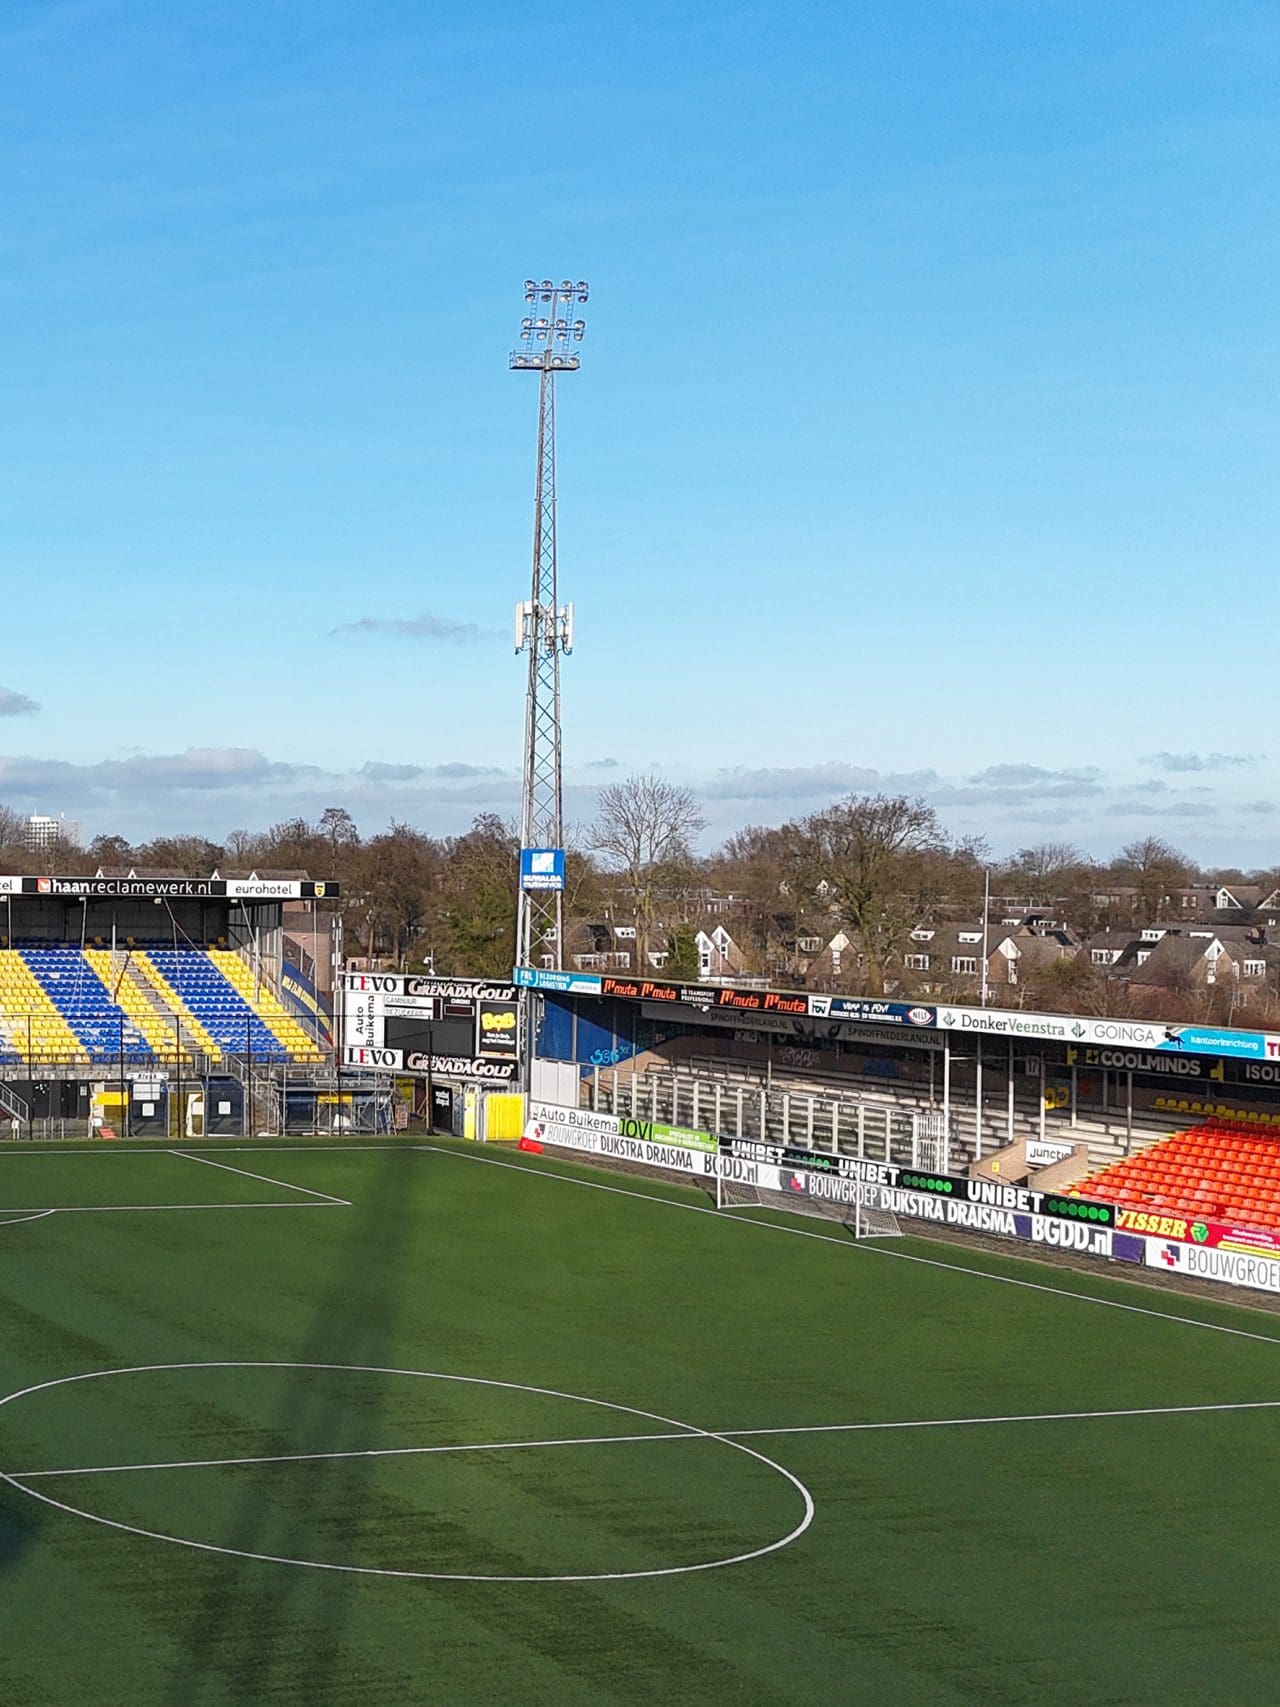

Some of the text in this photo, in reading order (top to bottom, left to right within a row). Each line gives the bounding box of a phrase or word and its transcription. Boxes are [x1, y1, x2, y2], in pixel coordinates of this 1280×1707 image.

[51, 878, 213, 896] haanreclamewerk.nl
[235, 882, 293, 895] eurohotel
[348, 976, 397, 993] LEVO
[355, 1006, 364, 1035] Auto
[365, 995, 375, 1046] Buikema
[1093, 1024, 1156, 1043] GOINGA
[848, 1027, 941, 1046] SPINOFFNEDERLAND.NL
[348, 1047, 397, 1067] LEVO
[1100, 1050, 1201, 1075] COOLMINDS
[539, 1107, 566, 1122] Auto
[570, 1112, 618, 1133] Buikema
[620, 1118, 653, 1142] JOVI
[546, 1125, 598, 1150] BOUWGROEP
[600, 1135, 644, 1161] DIJKSTRA
[646, 1143, 693, 1169] DRAISMA
[731, 1140, 786, 1166] UNIBET
[838, 1159, 900, 1187] UNIBET
[967, 1181, 1045, 1214] UNIBET
[880, 1188, 945, 1221] DIJKSTRA
[947, 1201, 1018, 1236] DRAISMA
[1031, 1214, 1113, 1257] BGDD.nl
[1116, 1209, 1188, 1239] VISSER
[1188, 1248, 1280, 1289] BOUWGROE
